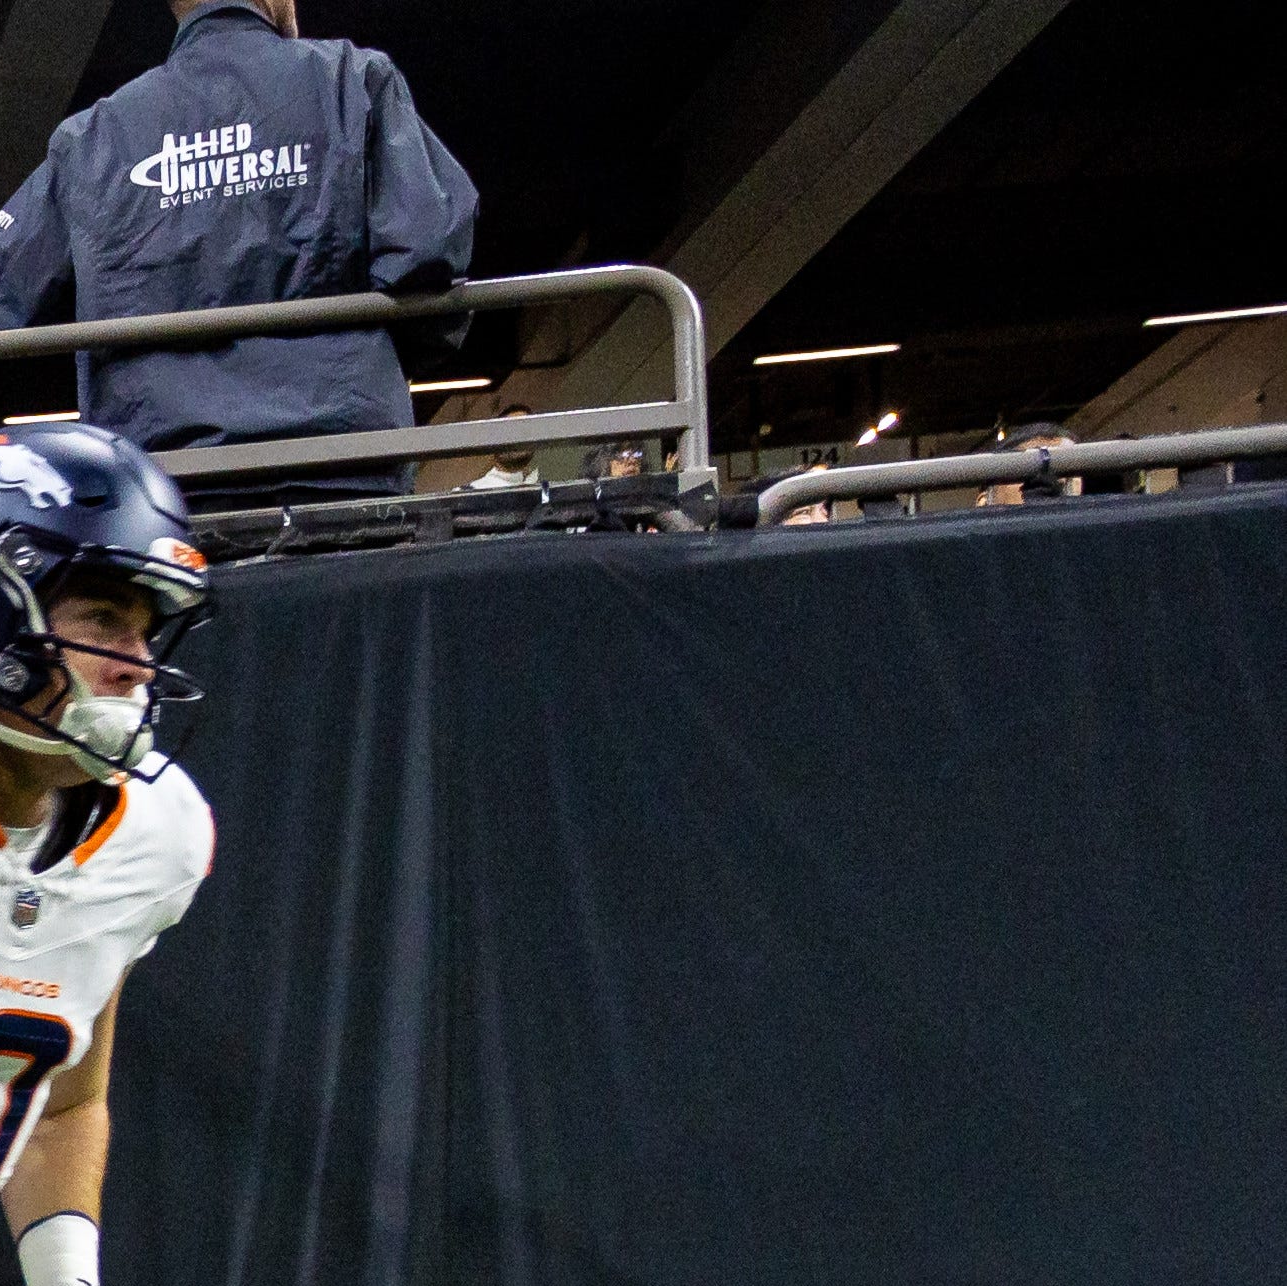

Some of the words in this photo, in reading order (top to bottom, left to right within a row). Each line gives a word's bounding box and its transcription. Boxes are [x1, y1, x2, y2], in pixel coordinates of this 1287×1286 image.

[162, 122, 252, 159] ALLIED
[160, 144, 309, 196] UNIVERSAL
[159, 187, 212, 209] EVENT
[223, 174, 308, 198] SERVICES
